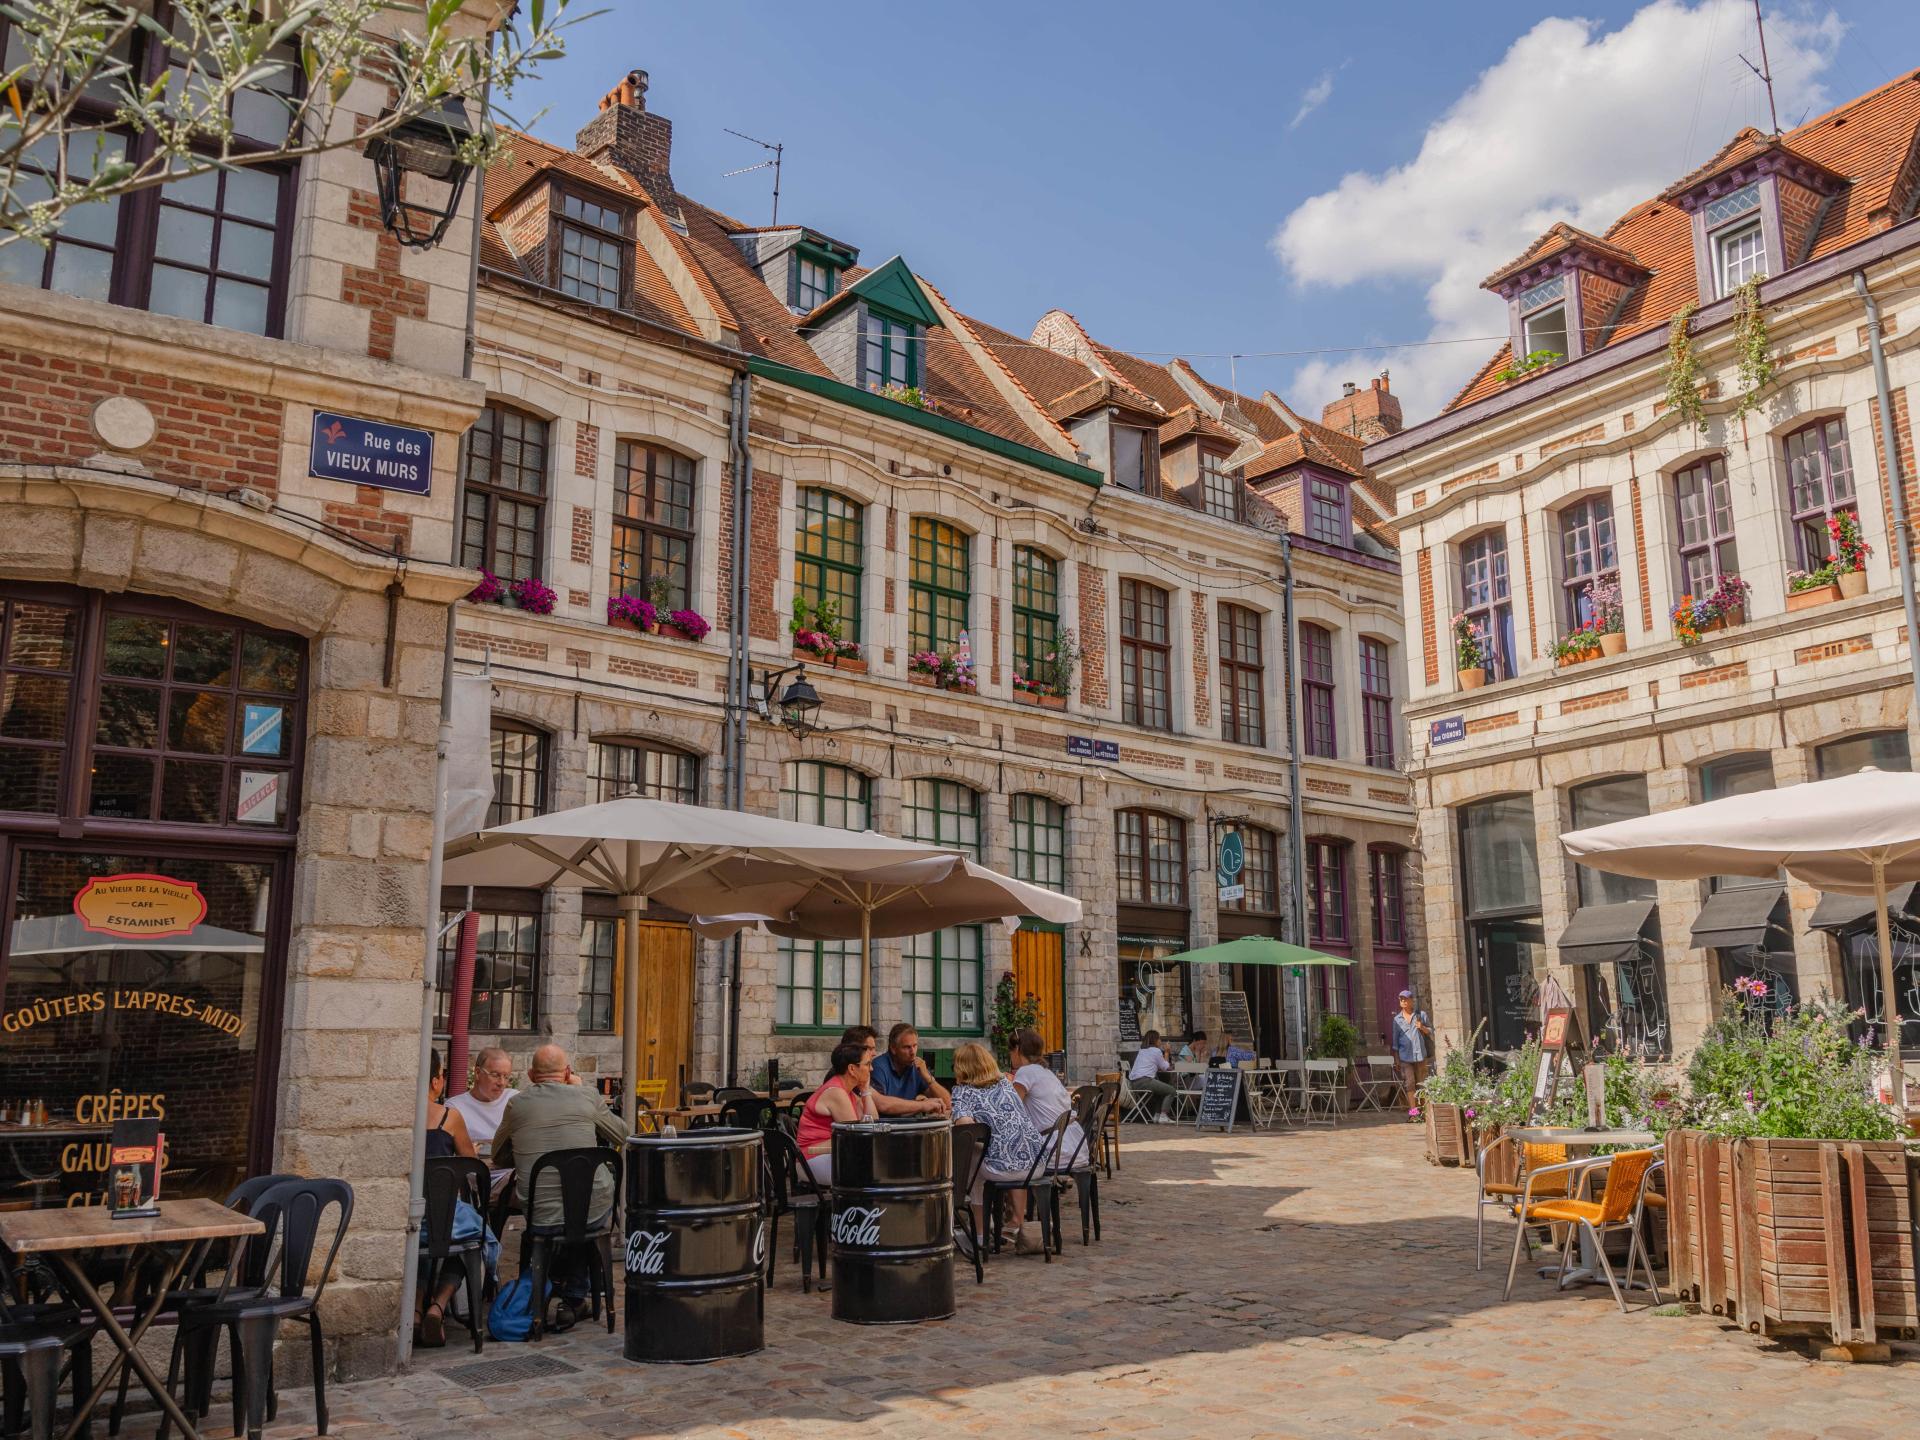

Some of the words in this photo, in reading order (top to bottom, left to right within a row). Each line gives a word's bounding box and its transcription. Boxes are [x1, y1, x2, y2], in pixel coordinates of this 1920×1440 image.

[364, 431, 391, 450] Rue
[396, 438, 421, 456] des
[327, 450, 371, 473] VIEUX
[376, 459, 418, 481] MURS
[245, 776, 254, 784] IV
[244, 781, 275, 811] LICENCE
[95, 887, 107, 895] AU
[136, 885, 147, 893] DE
[162, 887, 189, 900] VIEILLE
[106, 915, 176, 927] ESTAMINET
[3, 991, 105, 1032] GOÛTERS
[114, 991, 248, 1039] L'APRES-MIDI
[76, 1088, 165, 1124] CRÊPES
